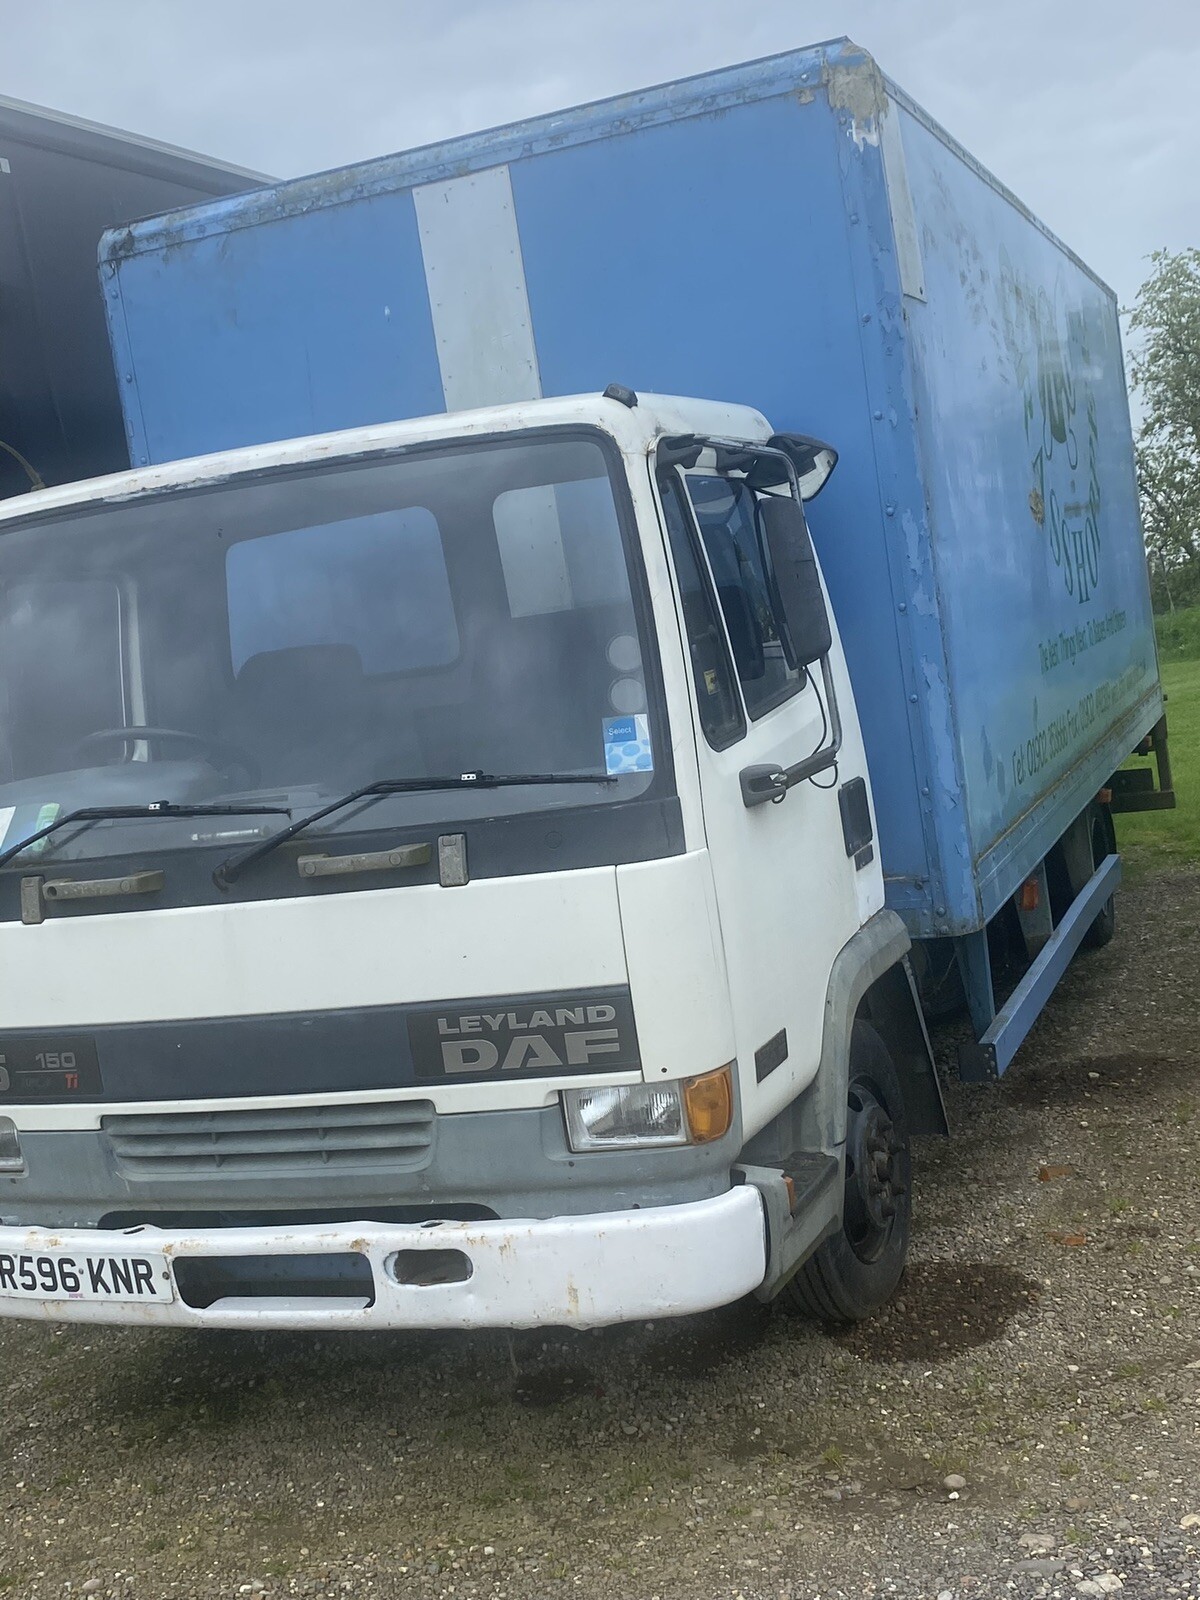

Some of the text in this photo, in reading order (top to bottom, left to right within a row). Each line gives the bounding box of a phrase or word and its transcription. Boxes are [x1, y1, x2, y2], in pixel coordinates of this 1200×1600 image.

[608, 726, 632, 736] Select
[437, 1004, 616, 1035] LEYLAND
[35, 1051, 77, 1069] 150
[440, 1028, 621, 1074] DAF
[0, 1254, 157, 1295] R596 KNR
